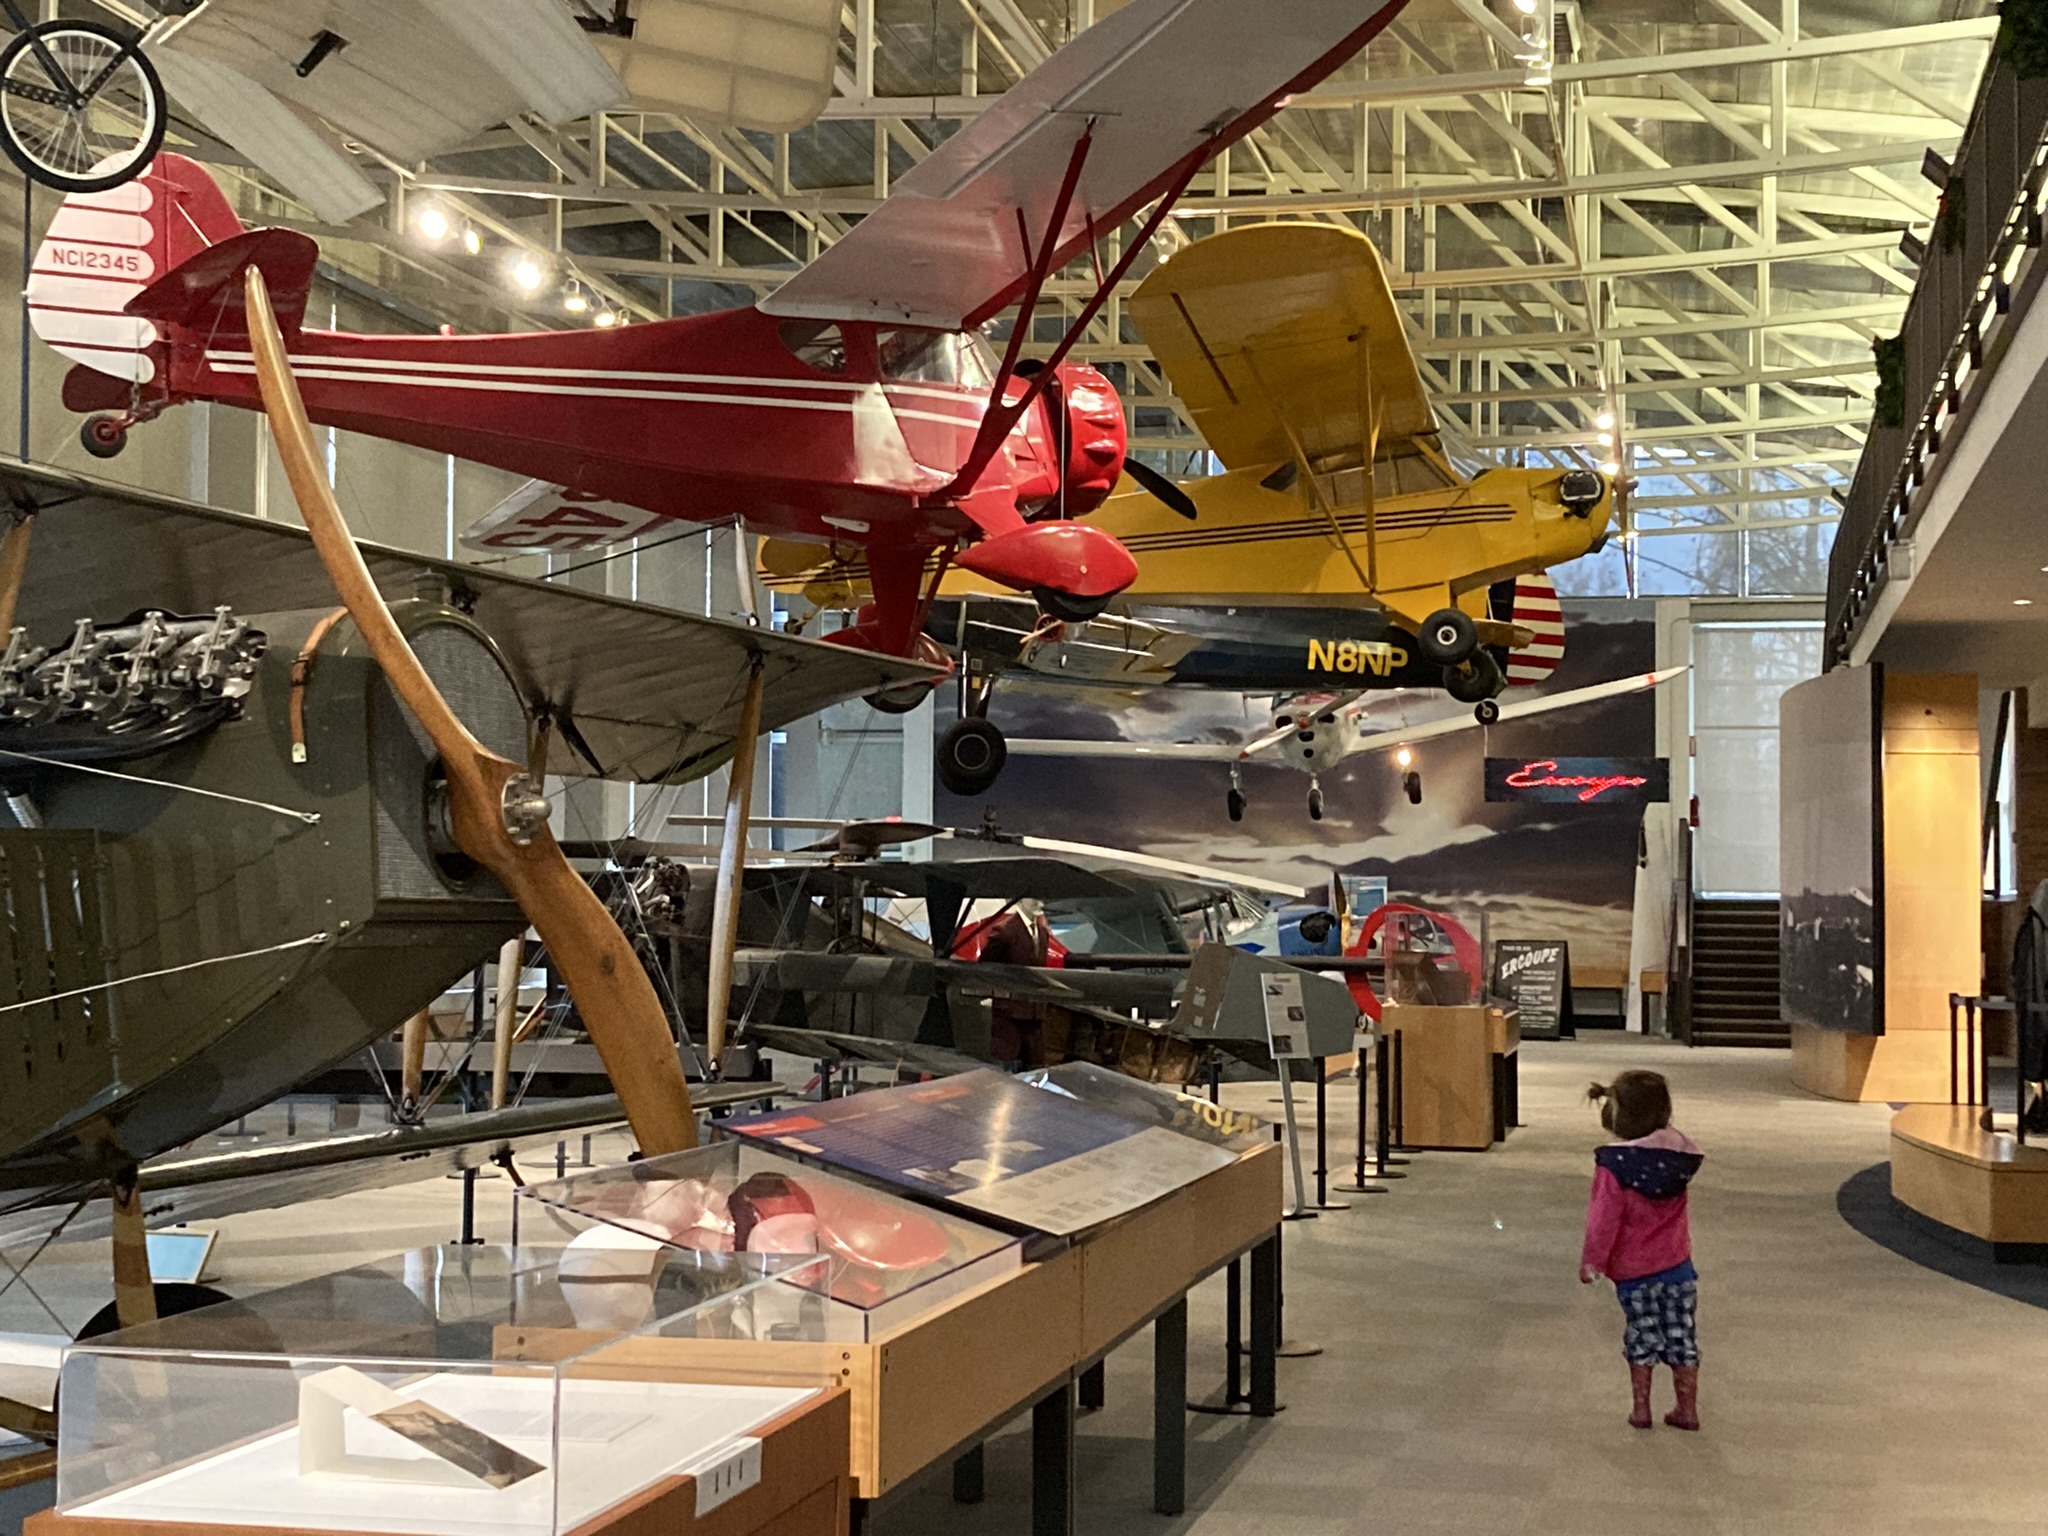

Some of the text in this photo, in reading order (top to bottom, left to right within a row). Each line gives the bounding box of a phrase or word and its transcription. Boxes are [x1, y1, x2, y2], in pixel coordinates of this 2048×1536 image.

[52, 248, 139, 272] NC12345
[1307, 638, 1409, 677] N8NP
[1501, 948, 1560, 979] ERCOUPE
